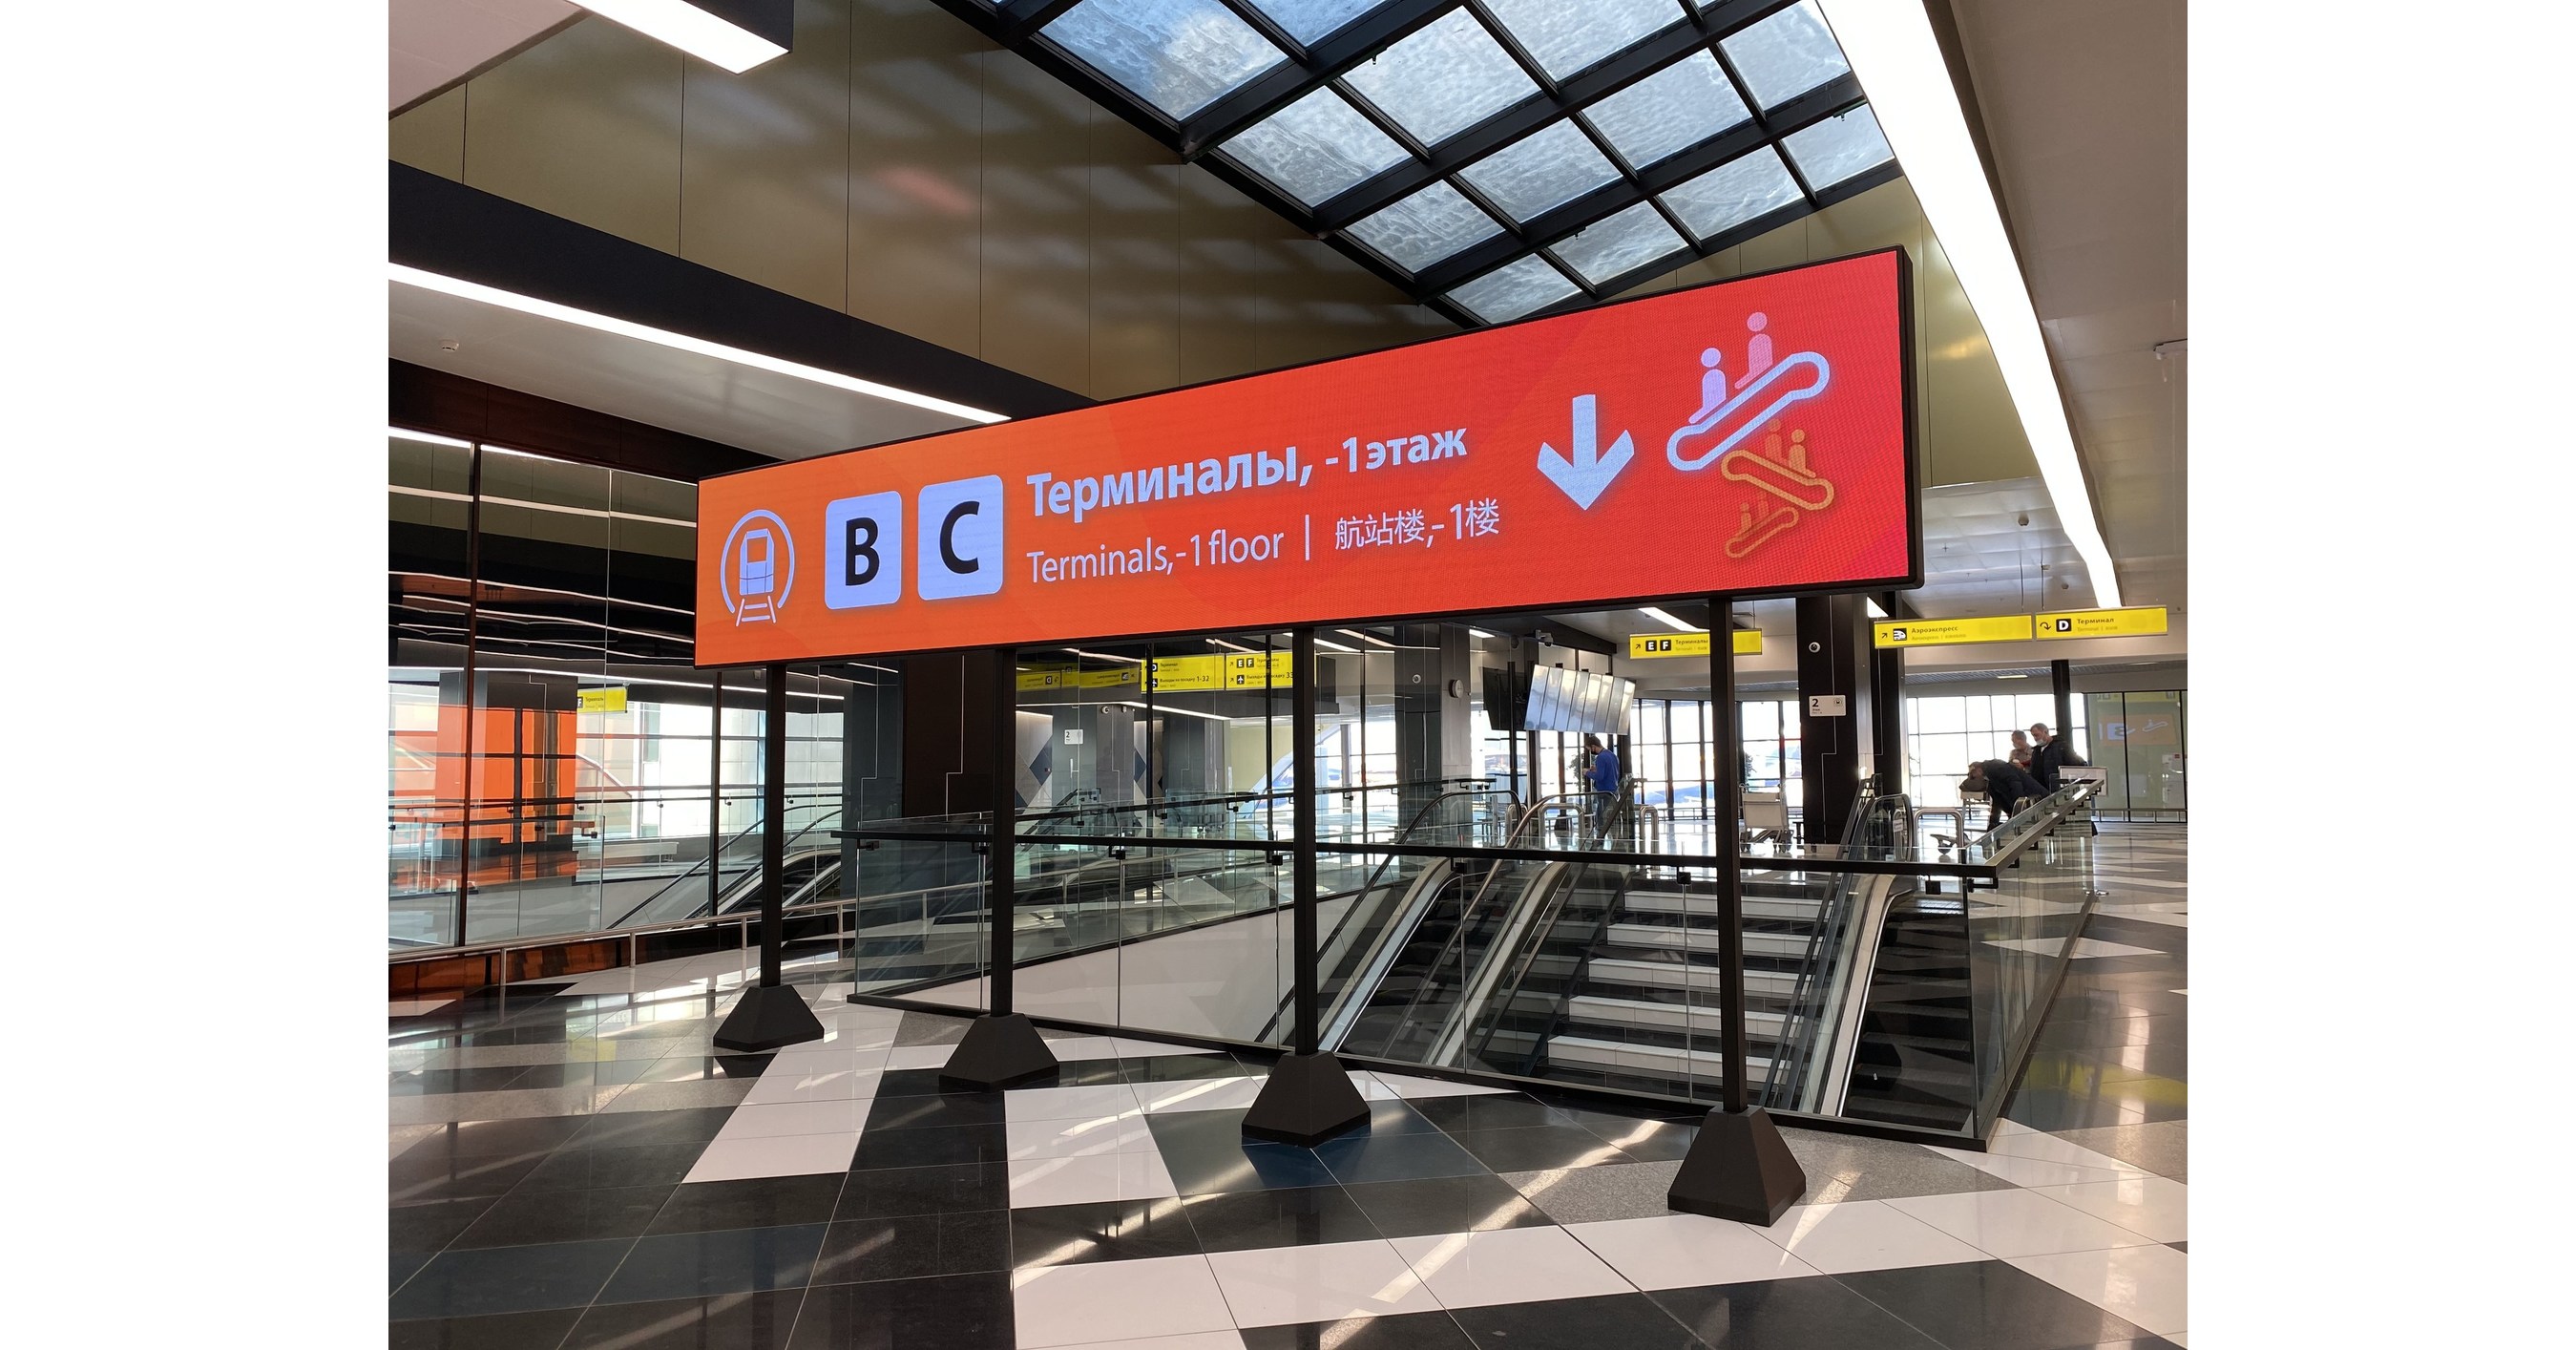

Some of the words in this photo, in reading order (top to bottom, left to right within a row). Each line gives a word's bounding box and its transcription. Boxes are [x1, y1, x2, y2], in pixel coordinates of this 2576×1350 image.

[1026, 446, 1313, 523] Терминалы,
[846, 517, 880, 586] B
[940, 501, 980, 574] C
[2059, 621, 2069, 630] D
[1912, 626, 1958, 635] Аэроэкспресс
[1648, 642, 1655, 650] E
[1662, 641, 1669, 650] F
[1812, 698, 1819, 707] 2
